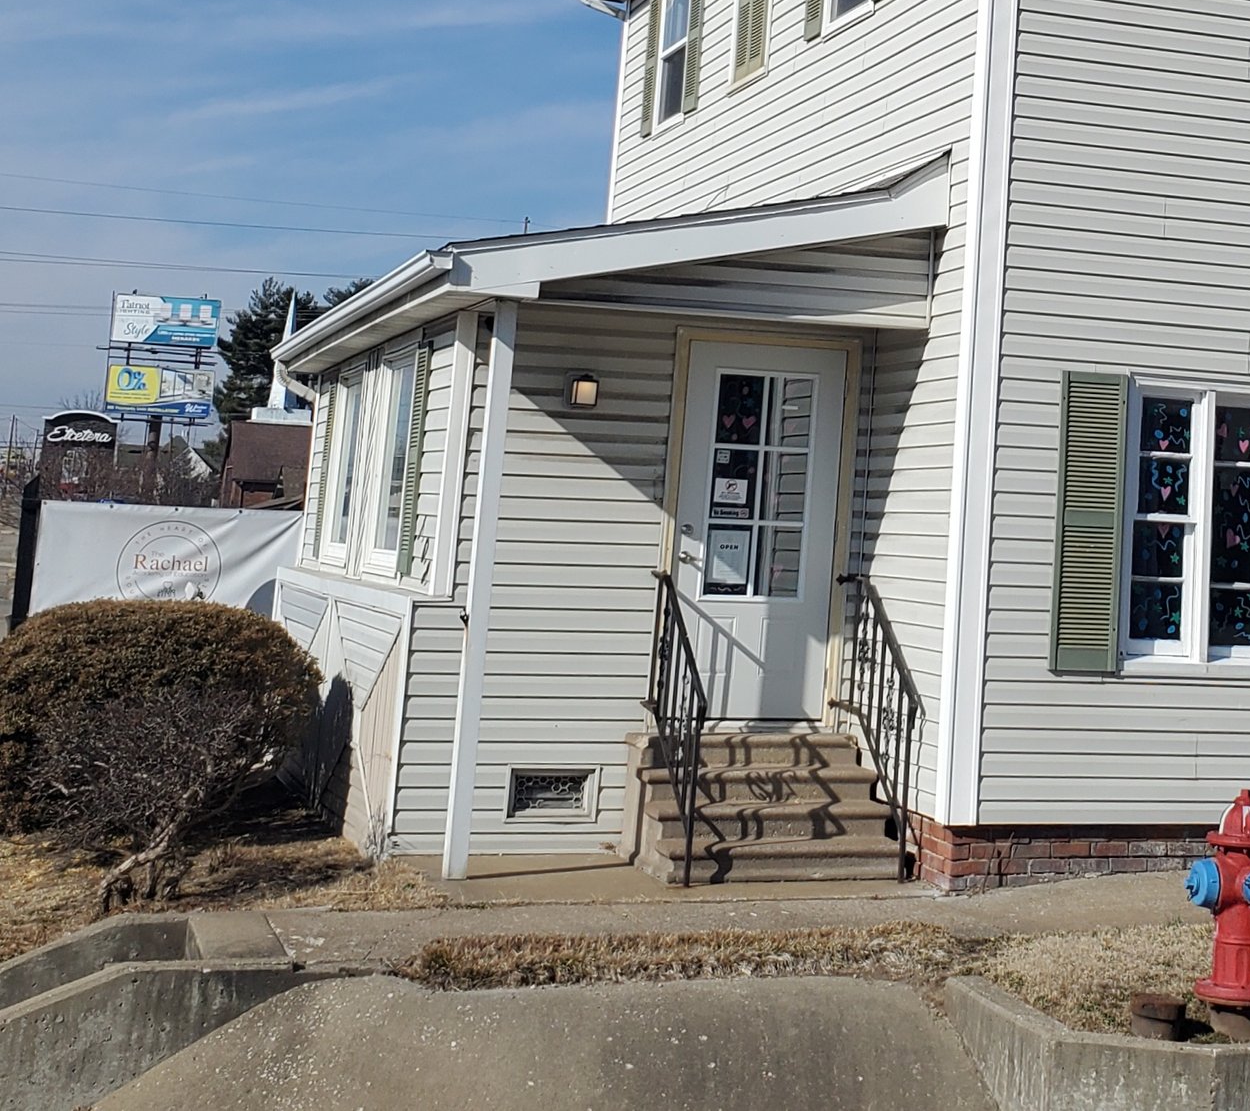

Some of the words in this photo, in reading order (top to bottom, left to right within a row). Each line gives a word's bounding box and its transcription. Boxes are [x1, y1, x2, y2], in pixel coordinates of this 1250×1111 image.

[124, 322, 151, 339] Style
[117, 367, 147, 391] 0%
[47, 425, 112, 442] Etcetera
[133, 554, 208, 572] Rachael
